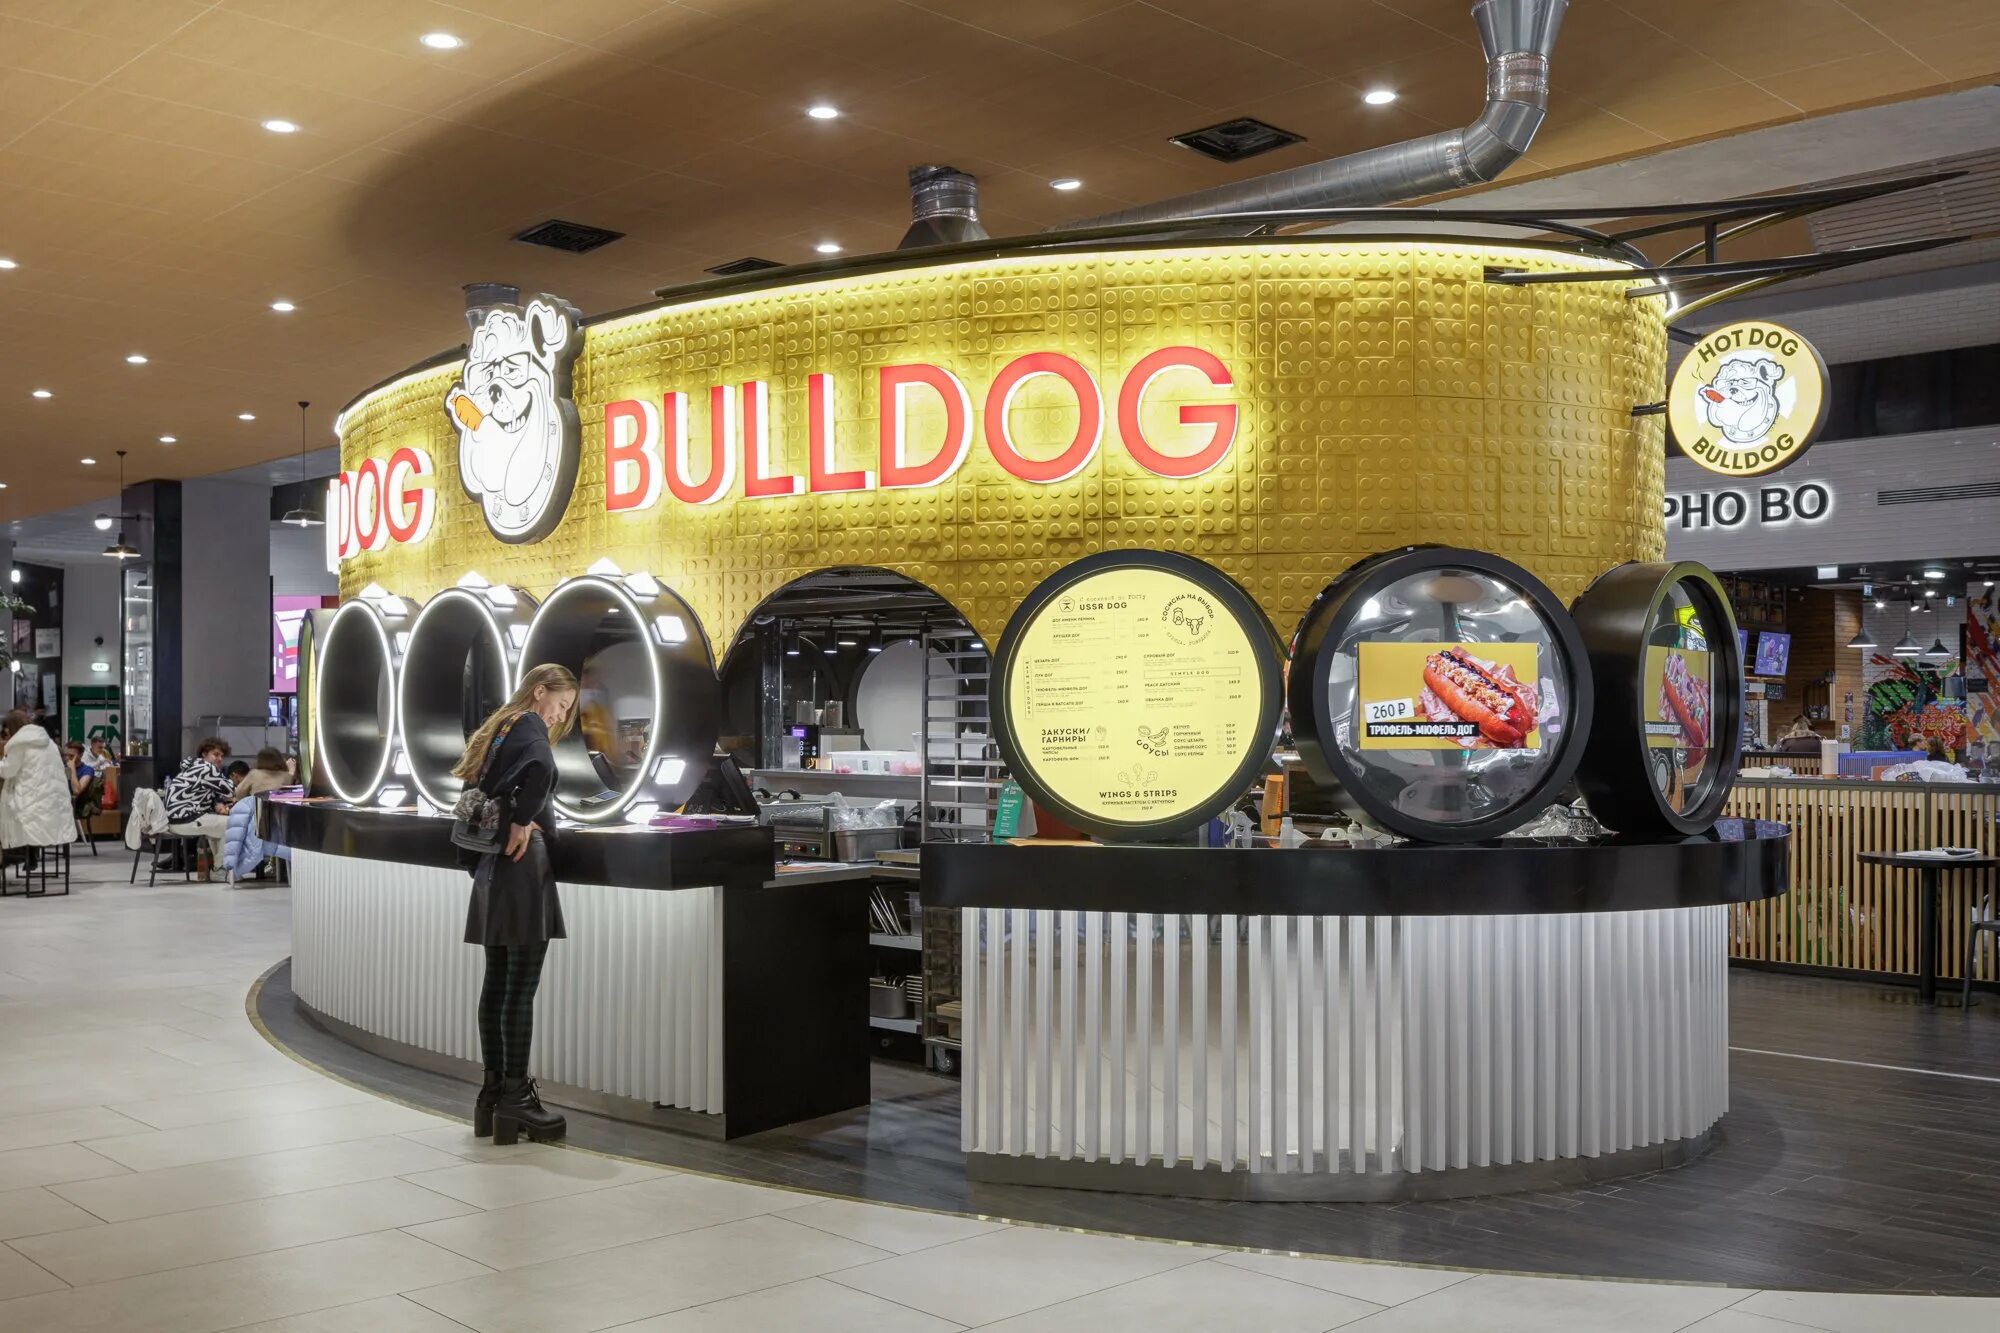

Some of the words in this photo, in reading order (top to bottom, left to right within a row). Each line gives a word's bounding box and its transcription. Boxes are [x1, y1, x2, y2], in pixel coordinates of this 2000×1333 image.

[1698, 328, 1744, 364] HOT
[1748, 328, 1800, 358] DOG
[606, 346, 1238, 512] BULLDOG
[1692, 432, 1794, 470] BULLDOG
[1760, 484, 1830, 524] BO
[1107, 602, 1128, 610] DOG
[1162, 594, 1186, 622] СОСИСКА
[1197, 596, 1214, 619] ВЫБОР
[1372, 704, 1395, 720] 260
[1041, 728, 1091, 736] ЗАКУСКИ/
[1370, 724, 1456, 736] ТРЮФЕЛЬ-МЮФЕЛЬ
[1456, 724, 1475, 736] ДОГ
[1136, 739, 1169, 757] СОУСЫ
[1099, 790, 1132, 798] WINGS
[1143, 789, 1177, 798] STRIPS
